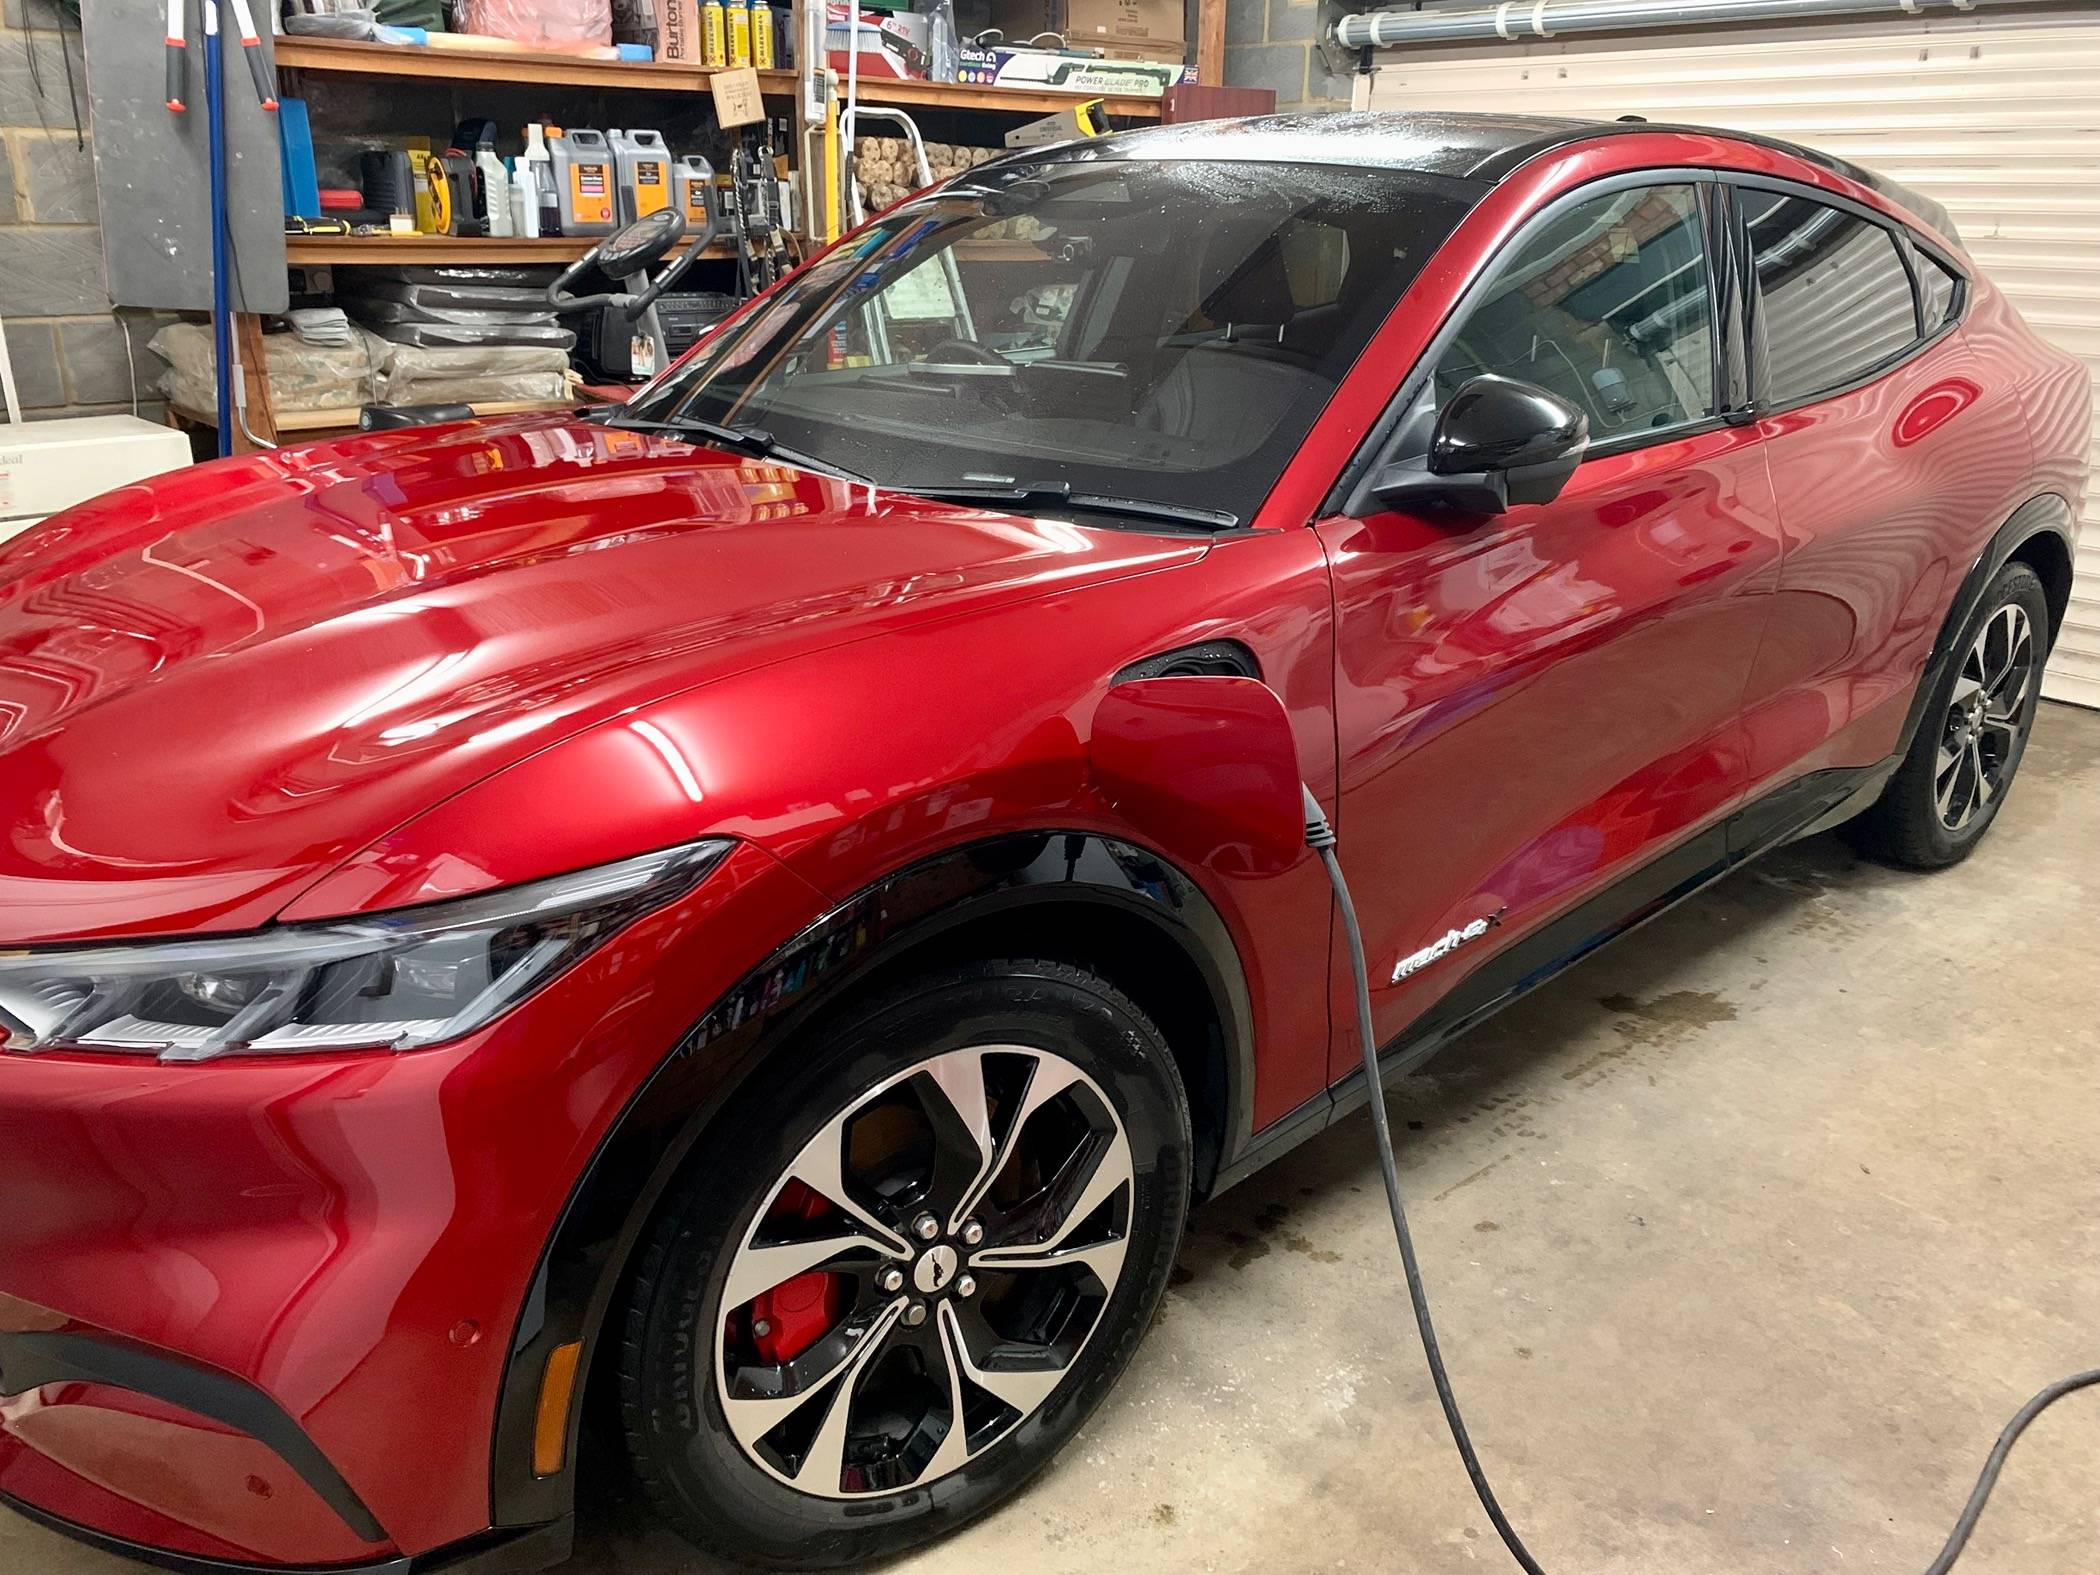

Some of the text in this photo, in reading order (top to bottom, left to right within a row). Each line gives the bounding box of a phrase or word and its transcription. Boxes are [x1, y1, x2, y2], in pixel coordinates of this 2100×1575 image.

[666, 0, 679, 59] Burton
[960, 49, 985, 61] Gtech
[1075, 75, 1104, 85] POWER
[1134, 78, 1150, 88] PRO
